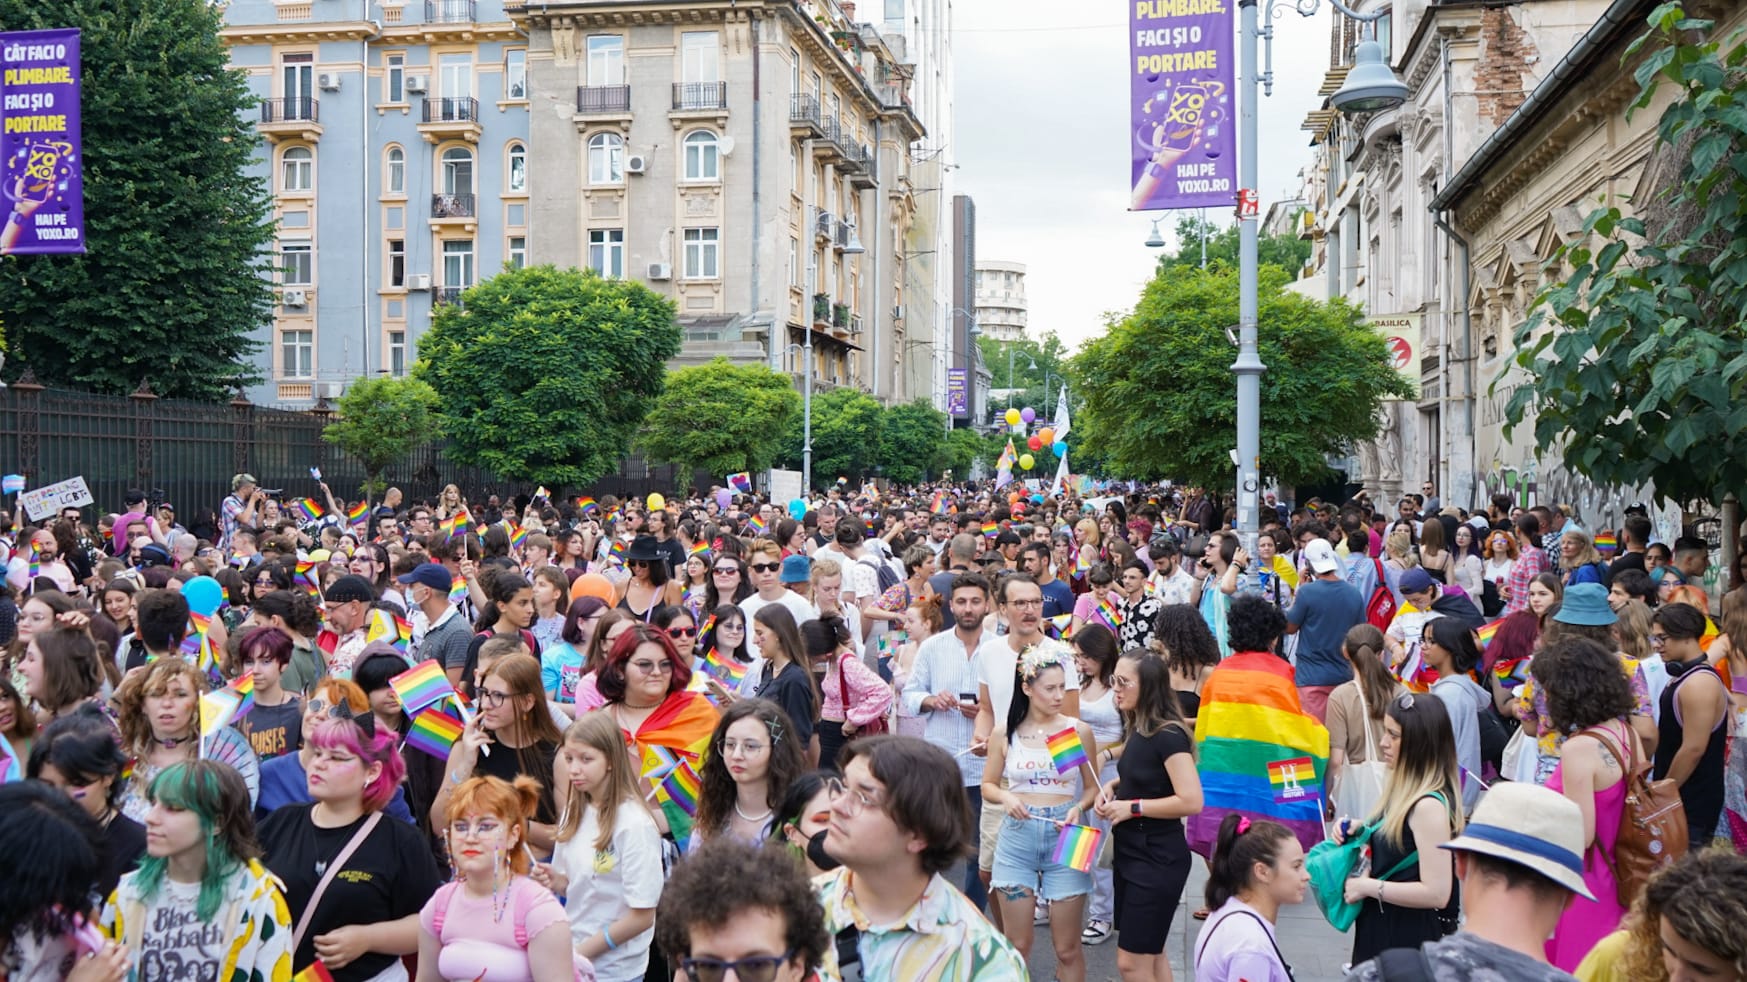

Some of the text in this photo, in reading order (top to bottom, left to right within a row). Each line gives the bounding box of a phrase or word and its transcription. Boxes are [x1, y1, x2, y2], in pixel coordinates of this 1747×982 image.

[1136, 0, 1226, 20] PLIMBARE,
[1136, 26, 1201, 48] FACI ȘI O
[4, 44, 65, 62] CÂT FACI O
[1137, 50, 1217, 74] PORTARE
[4, 66, 74, 86] PLIMBARE,
[4, 93, 54, 111] FACI ȘI O
[4, 115, 66, 134] PORTARE
[1177, 163, 1215, 178] HAI PE
[1177, 178, 1230, 194] YOXO.RO
[35, 213, 66, 226] HAI PE
[35, 227, 78, 240] YOXO.RO
[1375, 319, 1412, 328] BASILICA
[1017, 760, 1056, 770] LOVE
[1029, 778, 1068, 788] LOVE
[1034, 771, 1048, 780] IS
[153, 906, 208, 932] Blac
